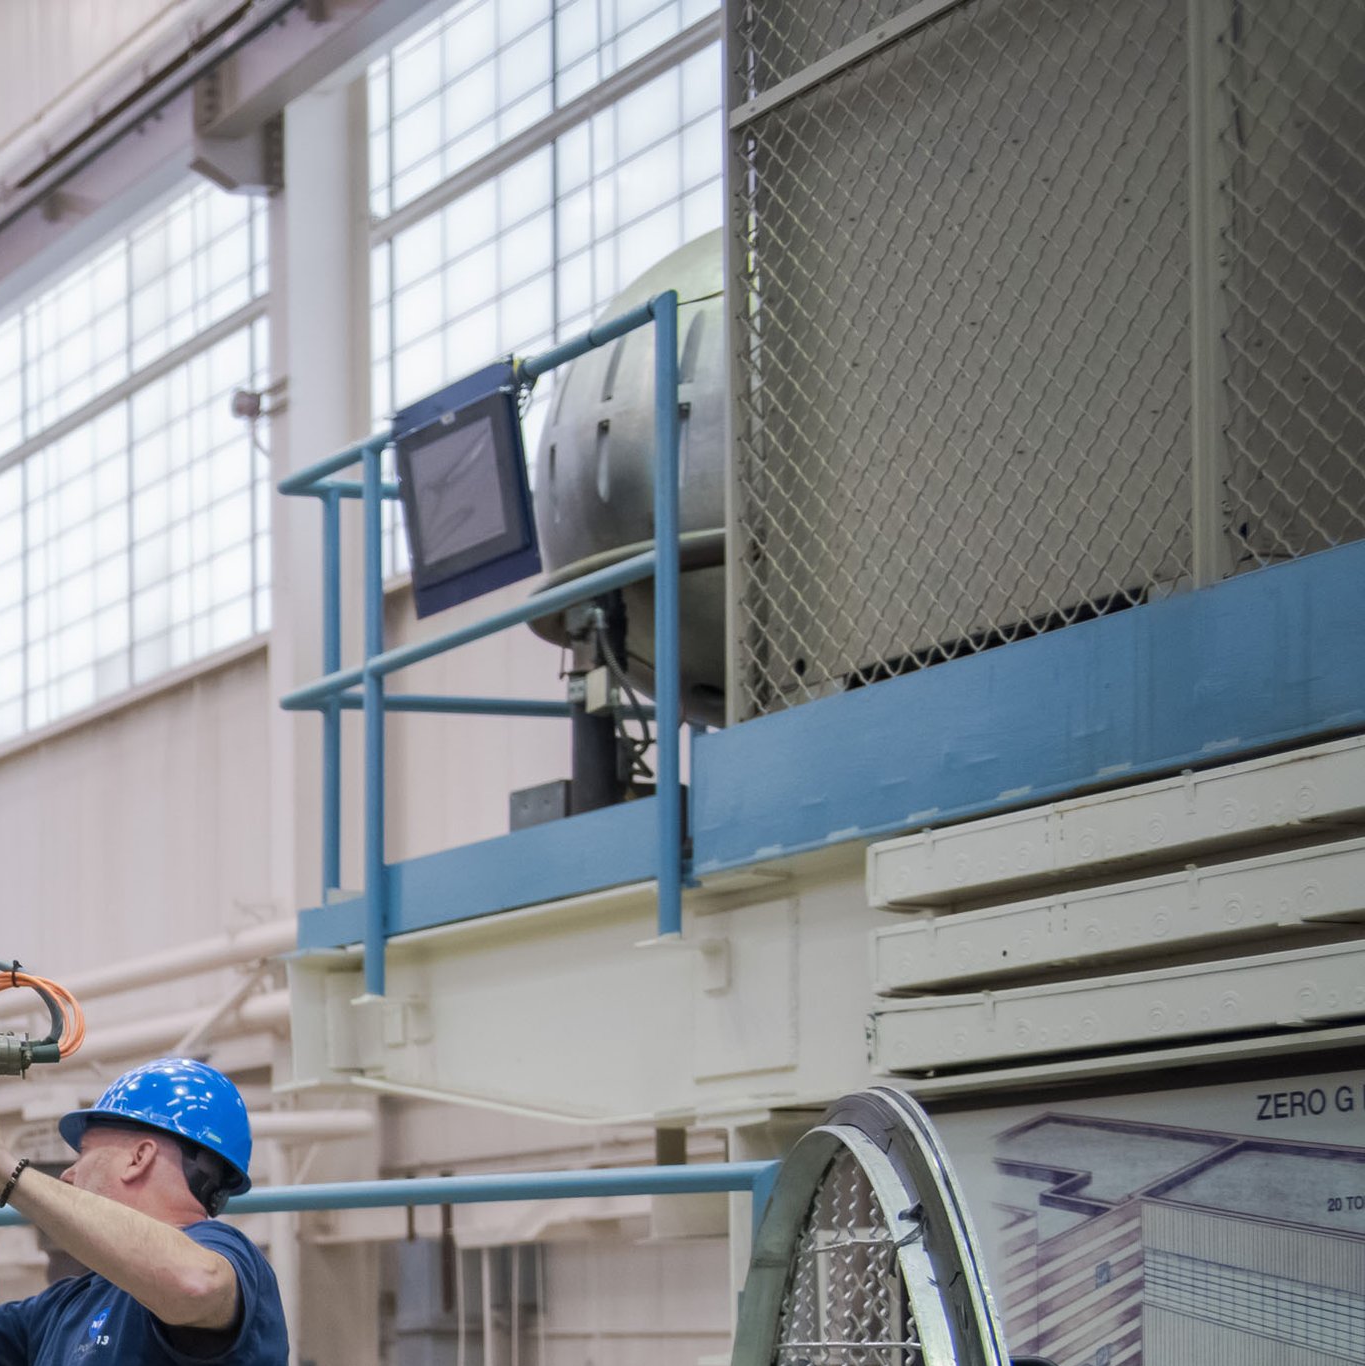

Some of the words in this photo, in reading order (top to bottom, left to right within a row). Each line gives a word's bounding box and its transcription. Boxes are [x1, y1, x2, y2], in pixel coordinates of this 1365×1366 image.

[1256, 1088, 1326, 1121] ZERO
[1335, 1085, 1354, 1112] G
[1327, 1197, 1342, 1212] 20
[96, 1335, 110, 1346] 13
